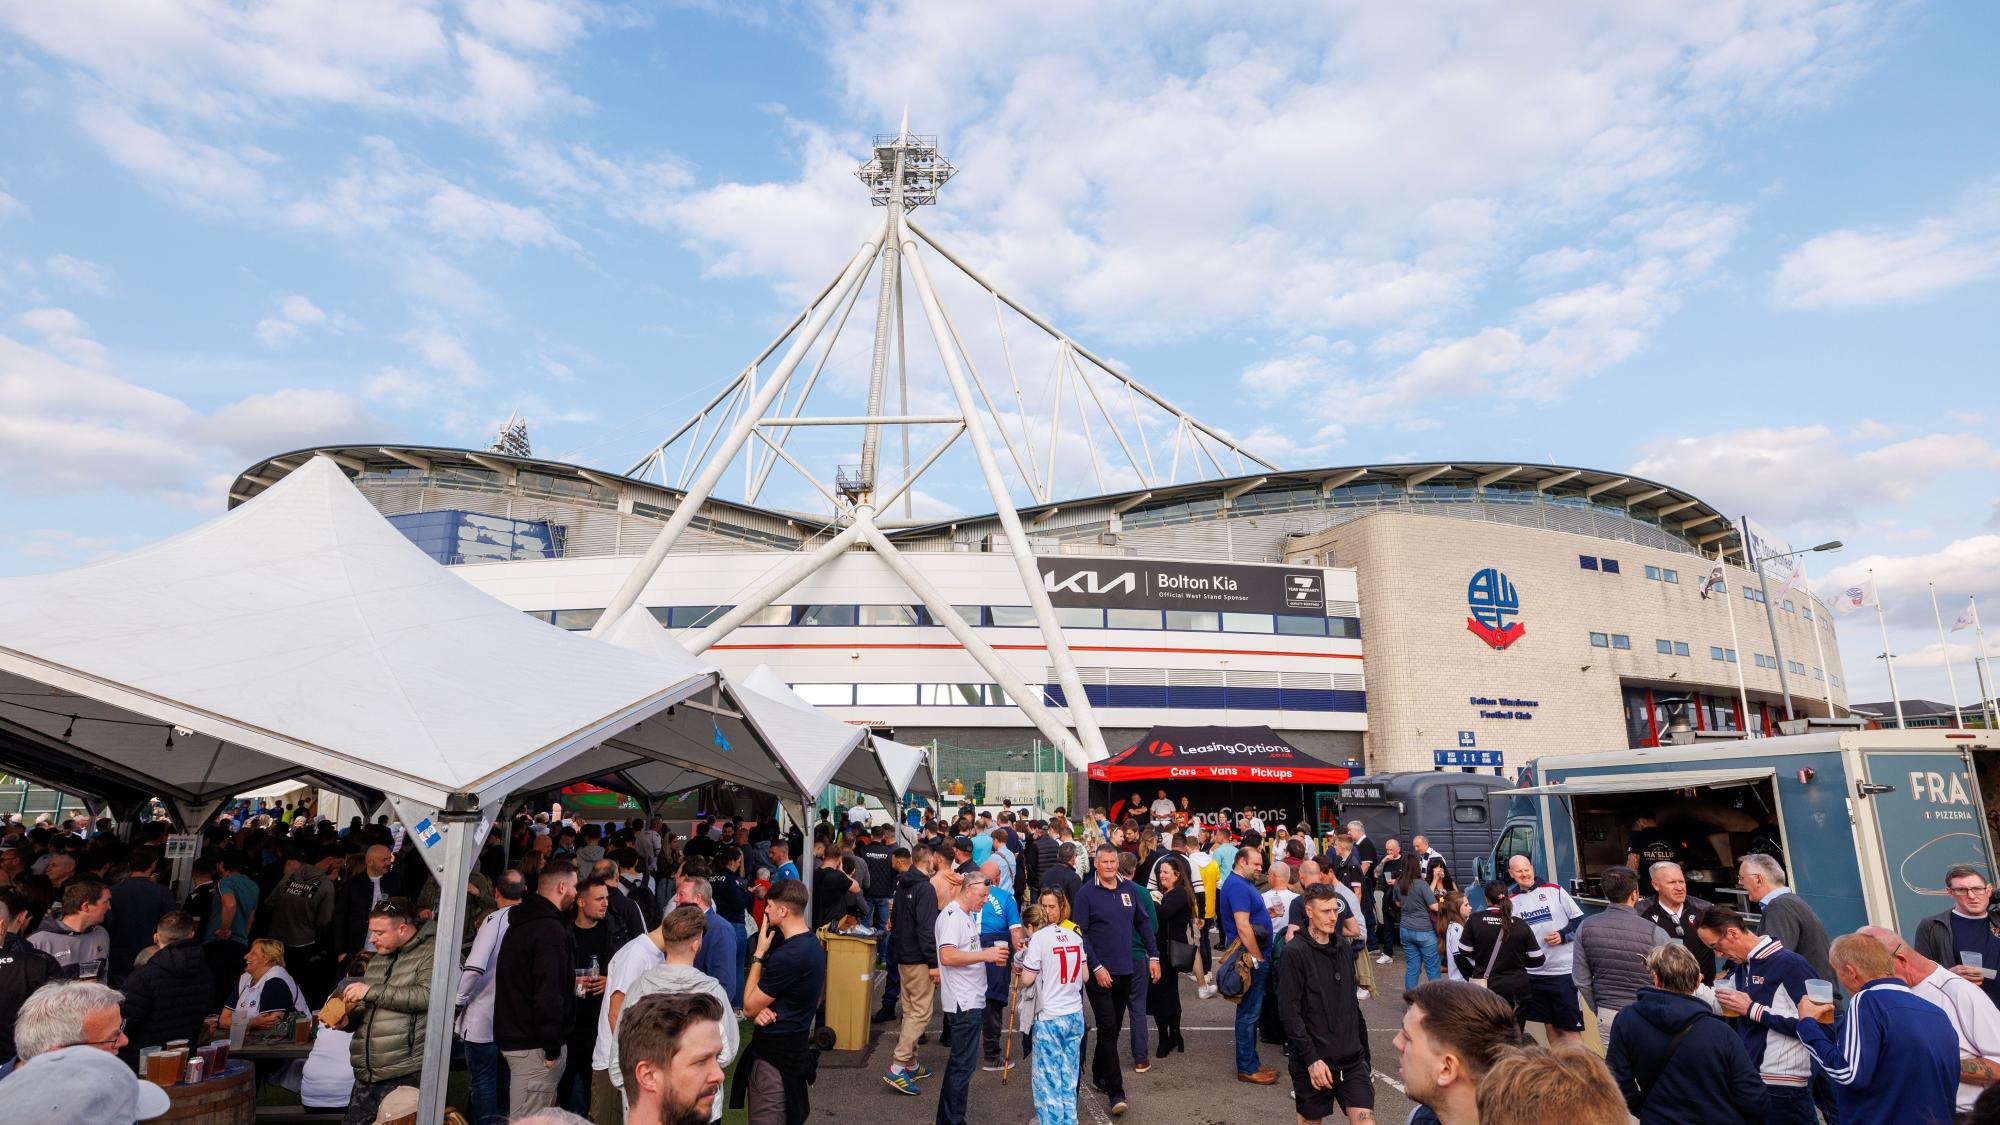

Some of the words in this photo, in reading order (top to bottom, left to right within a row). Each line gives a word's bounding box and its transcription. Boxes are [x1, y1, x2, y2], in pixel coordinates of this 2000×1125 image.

[1158, 573, 1209, 589] Bolton
[1213, 576, 1238, 591] Kia
[1294, 577, 1313, 600] 7
[1470, 696, 1498, 706] Bolton
[1499, 698, 1540, 707] Wanderers
[1480, 710, 1514, 719] Football
[1515, 711, 1533, 720] Club
[1179, 742, 1291, 756] LeasingOptions
[1170, 767, 1197, 777] Cars
[1210, 767, 1238, 777] Vans
[1251, 767, 1293, 780] Pickups
[1935, 811, 1972, 820] PIZZERIA
[290, 882, 313, 891] NORTH
[1520, 905, 1551, 920] Normid
[1053, 945, 1082, 984] 17
